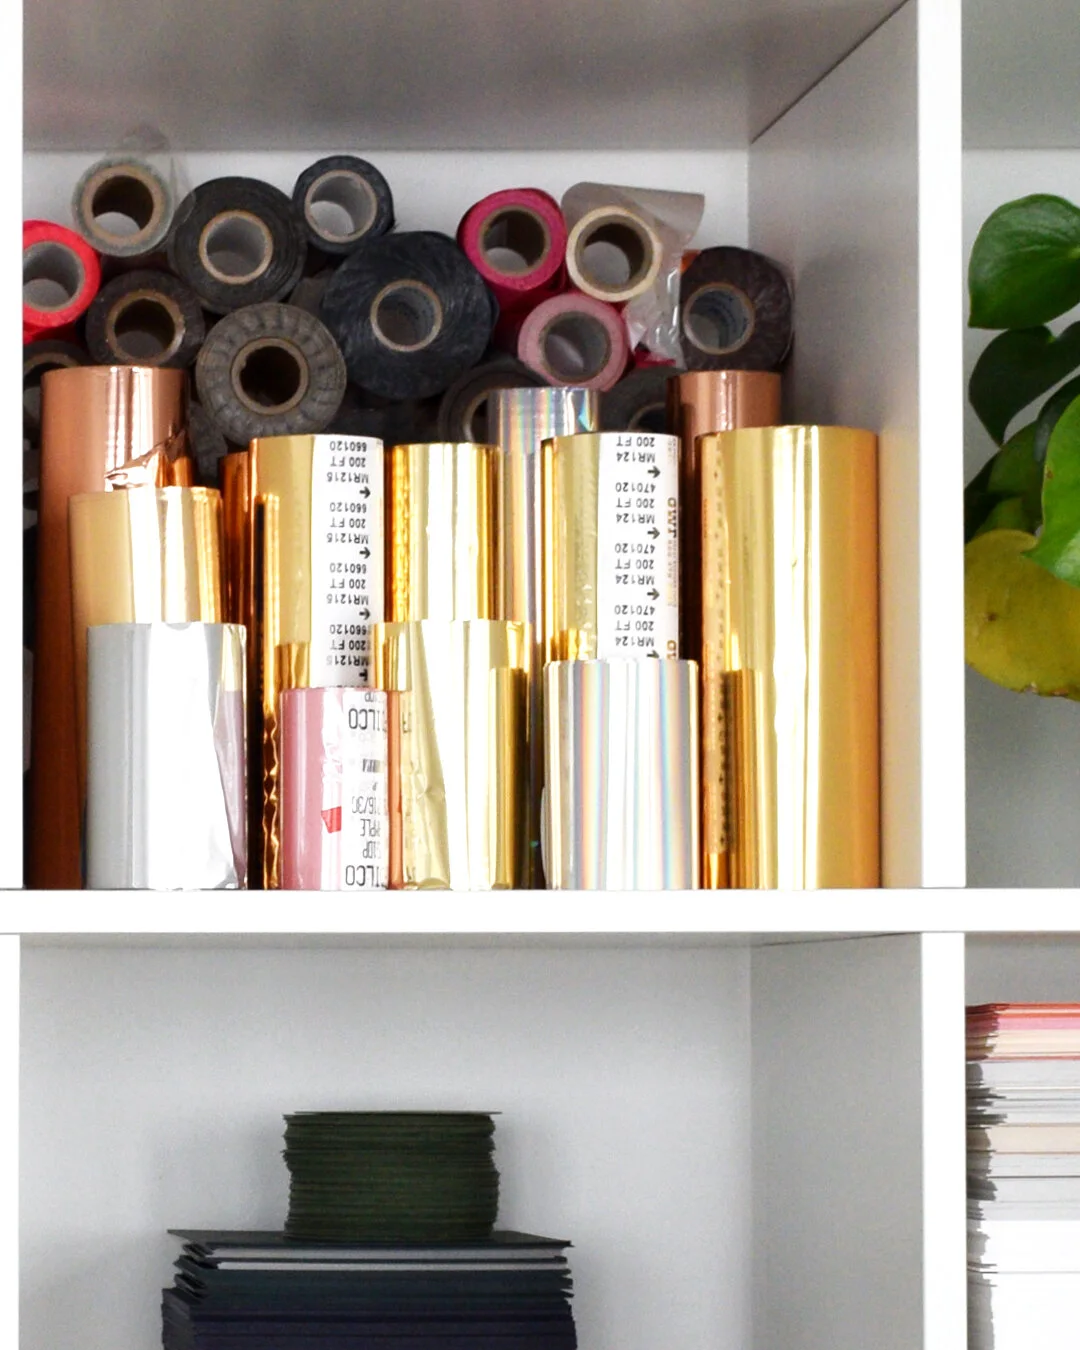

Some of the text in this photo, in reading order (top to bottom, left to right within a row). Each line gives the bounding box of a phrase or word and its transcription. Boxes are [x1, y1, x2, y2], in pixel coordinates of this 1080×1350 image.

[616, 436, 654, 447] 200 FT
[330, 456, 366, 467] 200 FT
[616, 452, 655, 462] MR124
[615, 482, 656, 493] 470120
[616, 498, 654, 508] 200 FT
[330, 518, 366, 528] 200 FT
[616, 513, 655, 523] MR124
[614, 543, 656, 554] 470120
[615, 559, 654, 569] 200 FT
[330, 578, 366, 589] 200 FT
[615, 574, 655, 585] MR124
[614, 605, 656, 615] 470120
[615, 620, 654, 631] 200 FT
[330, 640, 366, 651] 200 FT
[615, 636, 655, 646] MR124
